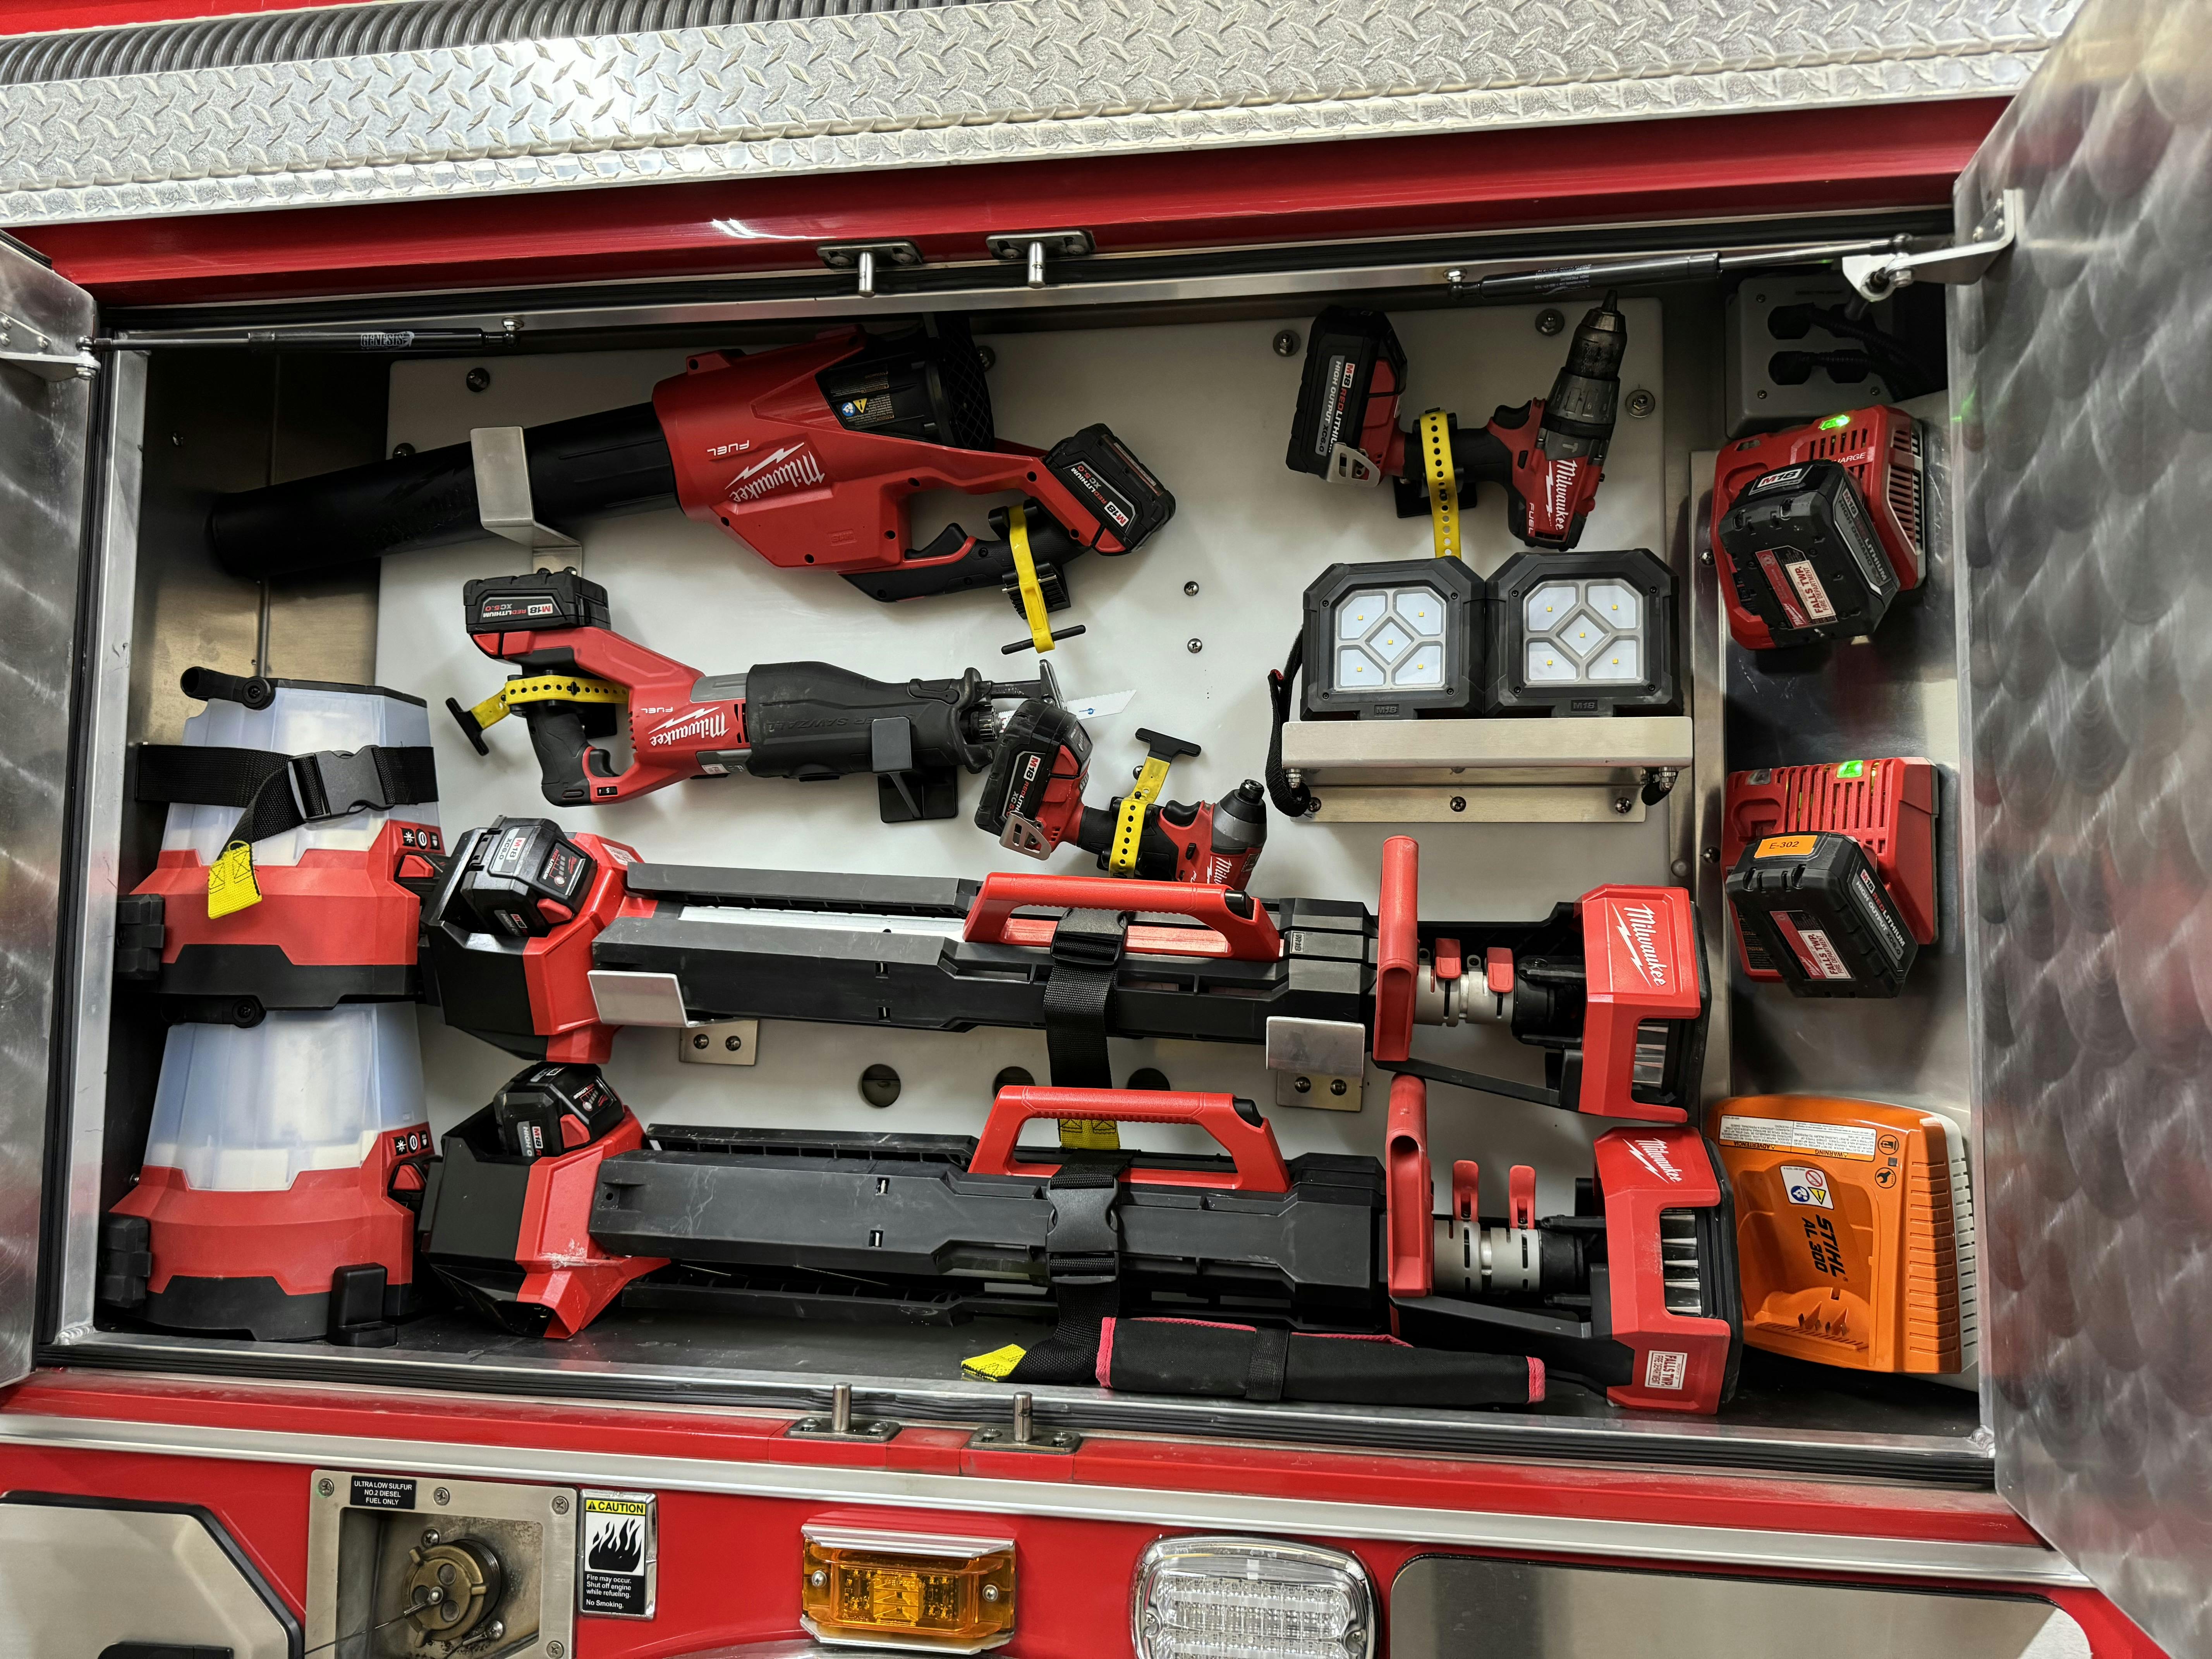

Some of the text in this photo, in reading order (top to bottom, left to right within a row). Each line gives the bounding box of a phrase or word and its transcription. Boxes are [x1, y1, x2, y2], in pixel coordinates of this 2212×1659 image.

[361, 333, 404, 347] GENESIS
[1332, 361, 1341, 385] HIGH
[1344, 364, 1354, 387] M18
[1325, 386, 1336, 424] OUTPUT
[707, 440, 749, 456] FUEL
[1834, 452, 1866, 464] ARGE
[729, 451, 825, 502] Milwaukee
[1078, 465, 1101, 489] XC5.0
[1762, 471, 1796, 484] M18
[1071, 467, 1127, 524] M18 REDLITHIUM
[1555, 460, 1578, 531] Milwaukee
[1844, 491, 1857, 515] M18
[1839, 500, 1852, 524] HIGH
[1851, 526, 1872, 566] DEMAND
[1795, 566, 1809, 586] TWP.
[1803, 567, 1823, 599] DEPARTMENT
[485, 603, 512, 611] XC5.0
[1805, 588, 1823, 613] FALLS
[1819, 599, 1829, 610] FIRE
[483, 609, 527, 618] REDLITHIUM
[1376, 706, 1398, 715] M18
[649, 712, 730, 746] Milwaukee
[766, 718, 849, 731] SAWZALL
[1026, 757, 1039, 779] M18
[499, 838, 512, 860] XC6.0
[510, 840, 522, 858] M18
[1769, 841, 1799, 849] E-302
[1856, 881, 1870, 902] HIGH
[1868, 902, 1888, 931] OUTPUT
[1862, 871, 1905, 947] M18 REDLITHIUM
[512, 914, 526, 927] M18
[1623, 903, 1667, 988] Milwaukee
[1808, 934, 1823, 951] TWP.
[1816, 935, 1838, 963] DEPARTMENT
[1819, 953, 1838, 974] FALLS
[1834, 964, 1844, 973] FIRE
[534, 1128, 542, 1147] M18
[1734, 1140, 1770, 1149] ADVERTENCIA
[1635, 1138, 1683, 1183] Milwaukee
[1815, 1149, 1843, 1157] WARNING
[1802, 1216, 1828, 1273] AL 300
[1815, 1214, 1846, 1277] STIHL
[1661, 1355, 1677, 1386] FALLS TWP.
[598, 1501, 644, 1513] CAUTION
[596, 1600, 624, 1609] Smoking.
[603, 1590, 631, 1599] refueling.
